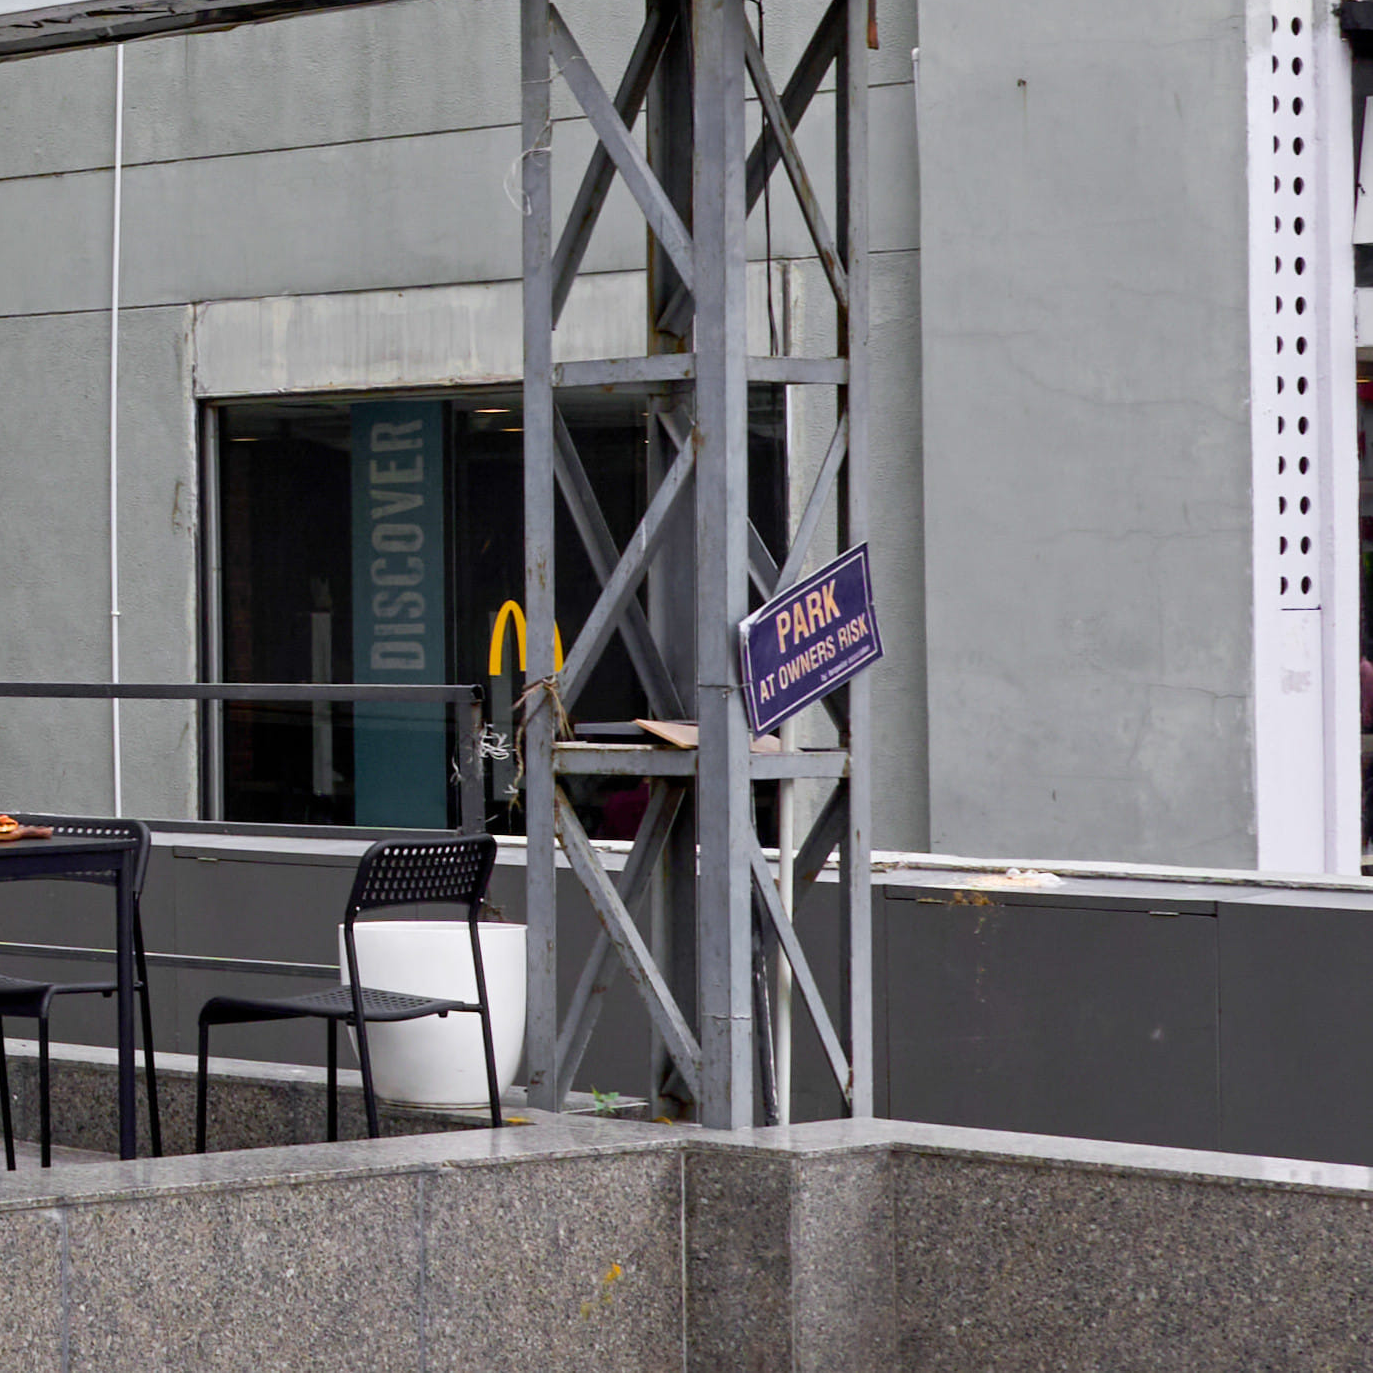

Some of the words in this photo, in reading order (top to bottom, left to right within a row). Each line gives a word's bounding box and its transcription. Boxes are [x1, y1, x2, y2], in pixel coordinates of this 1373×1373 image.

[369, 418, 426, 670] DISCOVER
[759, 672, 776, 704] AT
[778, 634, 836, 690] OWNERS
[837, 612, 869, 652] RISK
[776, 579, 842, 654] PARK
